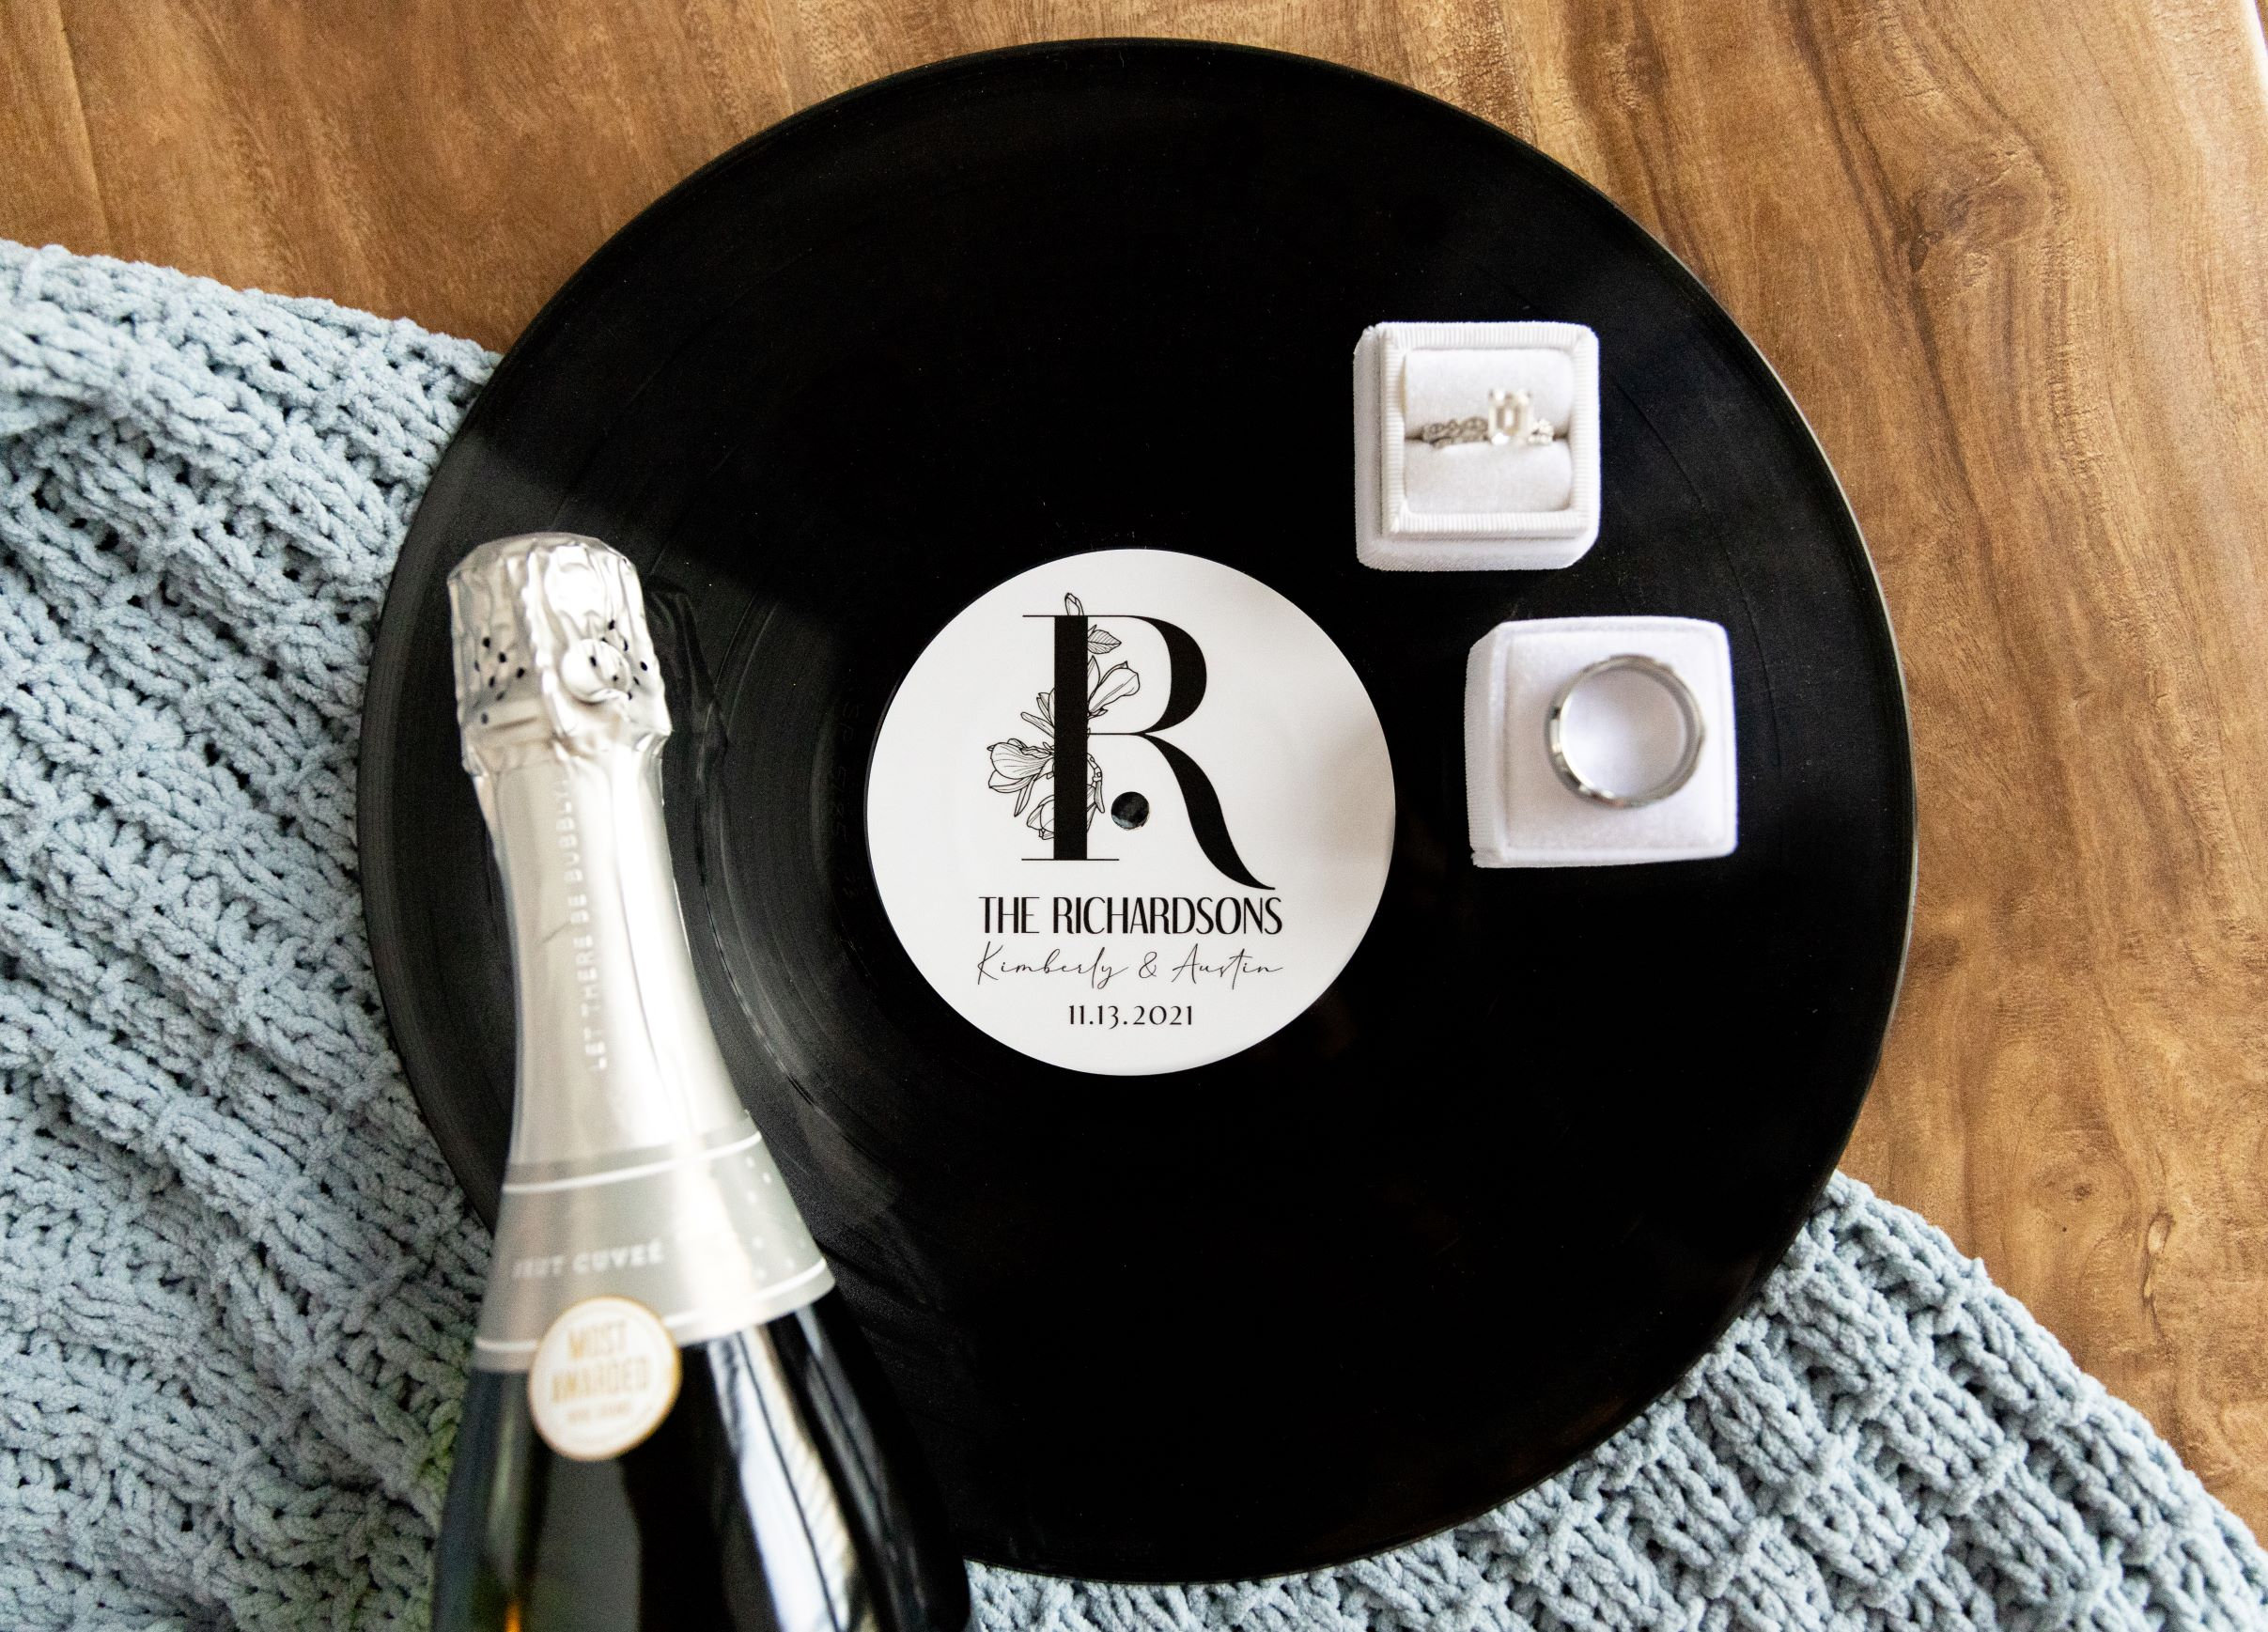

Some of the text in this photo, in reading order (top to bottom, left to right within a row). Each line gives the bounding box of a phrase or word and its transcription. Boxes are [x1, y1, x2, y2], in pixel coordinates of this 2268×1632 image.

[1021, 614, 1276, 891] R
[567, 894, 590, 925] BE
[978, 896, 1283, 936] THE RICHARDSONS
[571, 935, 601, 1018] THERE
[977, 940, 1284, 990] Kimberly & Austin
[1068, 1004, 1193, 1030] 11.13.2021
[583, 1027, 608, 1071] LET
